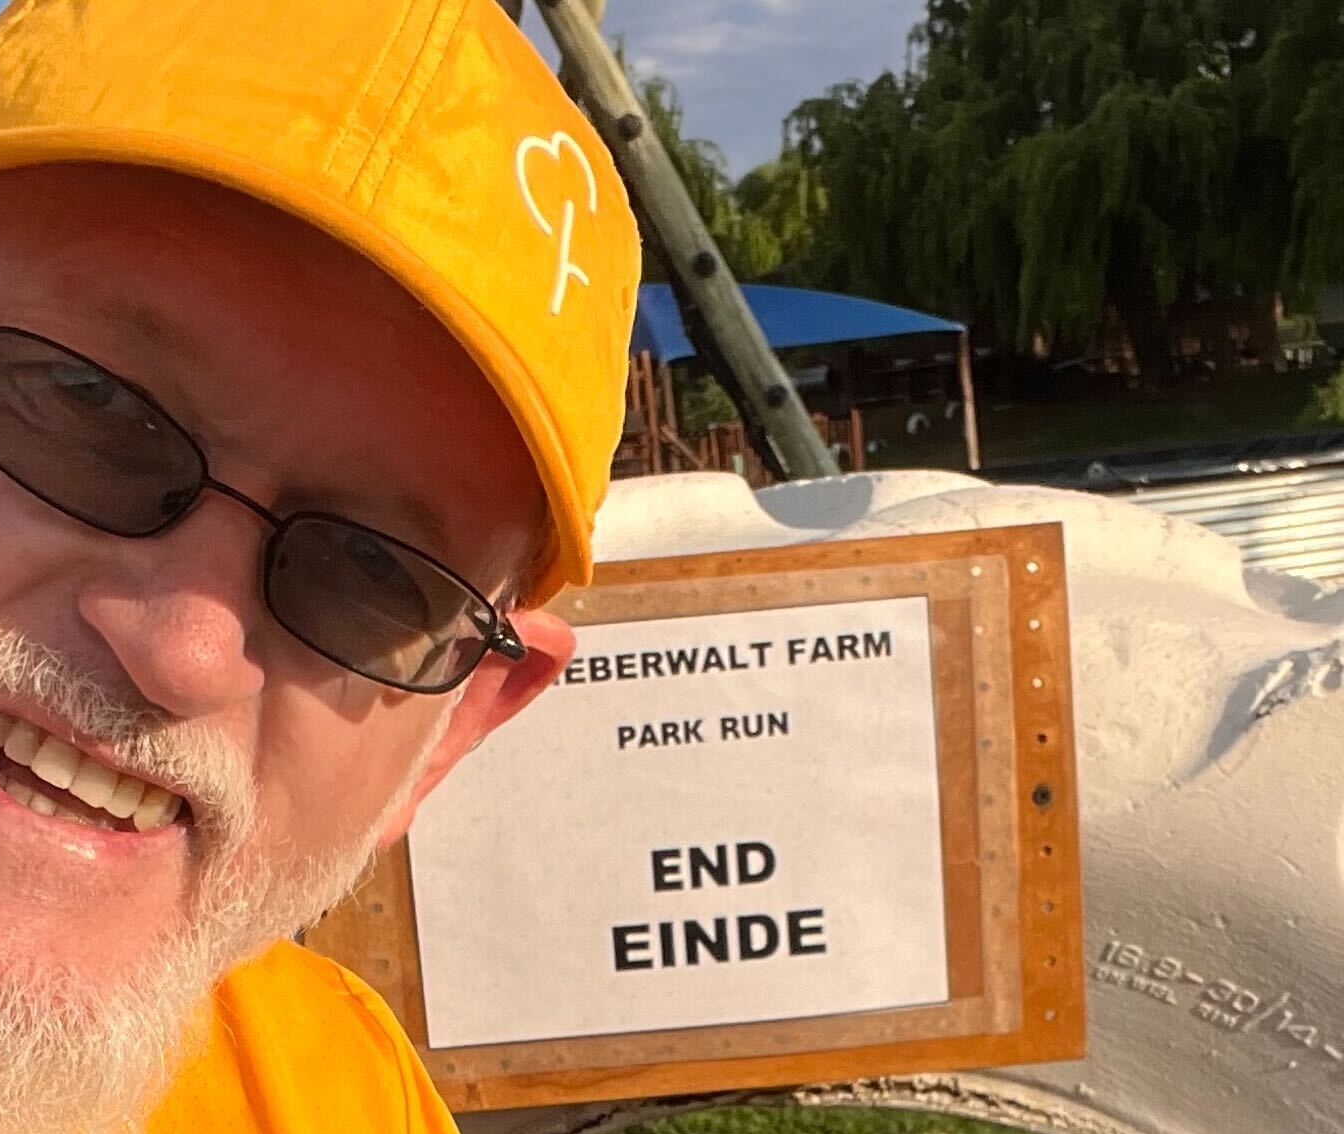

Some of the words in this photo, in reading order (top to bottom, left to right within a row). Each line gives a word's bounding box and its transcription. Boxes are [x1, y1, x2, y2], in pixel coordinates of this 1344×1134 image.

[553, 639, 772, 686] EBERWALT
[786, 630, 893, 666] FARM
[616, 719, 705, 750] PARK
[720, 711, 790, 740] RUN
[650, 841, 777, 893] END
[611, 909, 827, 972] EINDE
